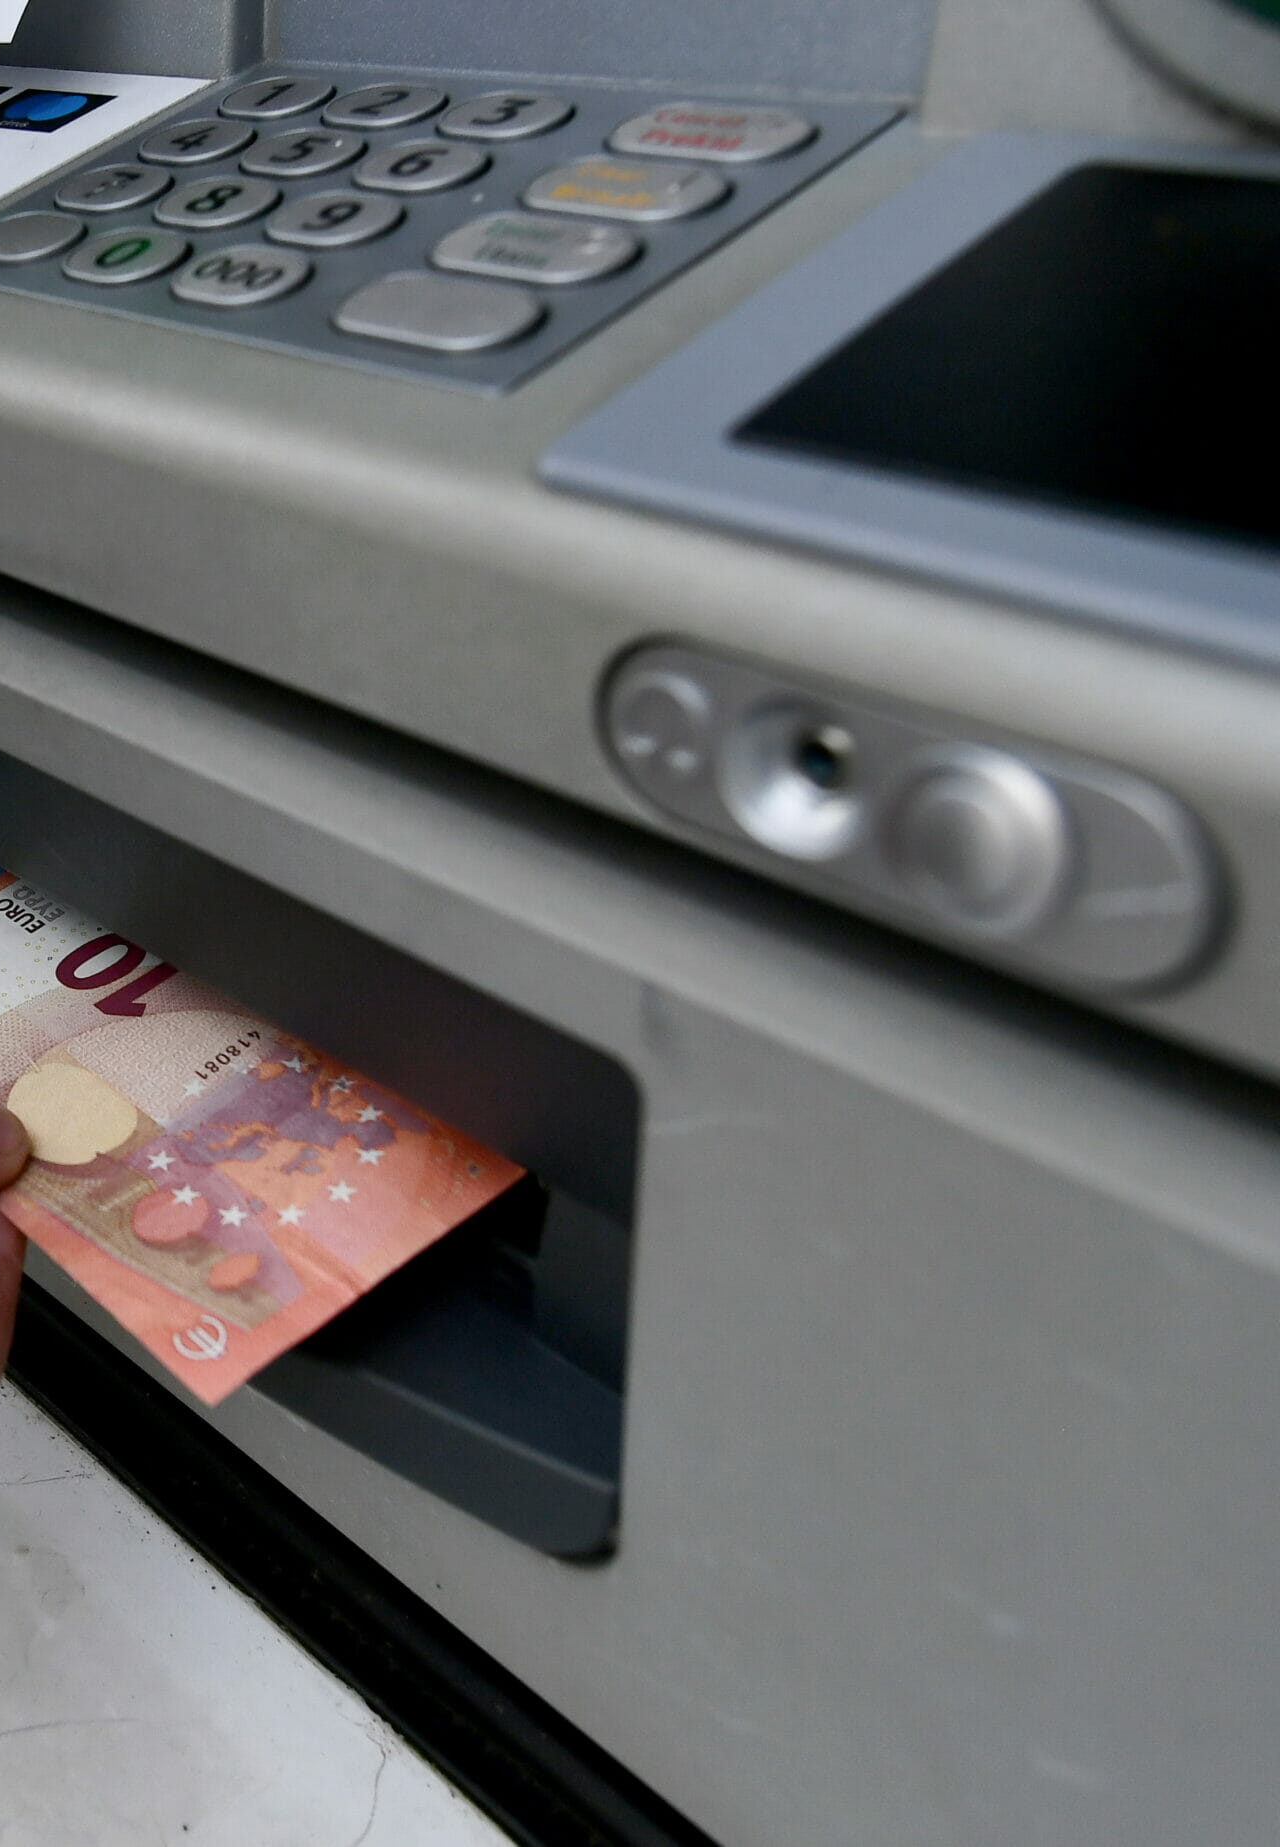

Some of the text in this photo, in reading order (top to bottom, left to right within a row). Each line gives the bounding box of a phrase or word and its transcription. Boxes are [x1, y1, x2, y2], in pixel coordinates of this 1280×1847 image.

[256, 84, 294, 106] 1
[350, 90, 410, 116] 2
[471, 97, 536, 125] 3
[169, 127, 217, 151] 4
[270, 136, 331, 163] 5
[388, 149, 449, 176] 6
[185, 184, 243, 213] 8
[299, 201, 362, 231] 9
[94, 238, 152, 267] 0
[192, 256, 283, 289] 000
[55, 932, 179, 1018] 10
[194, 1030, 262, 1081] 418081
